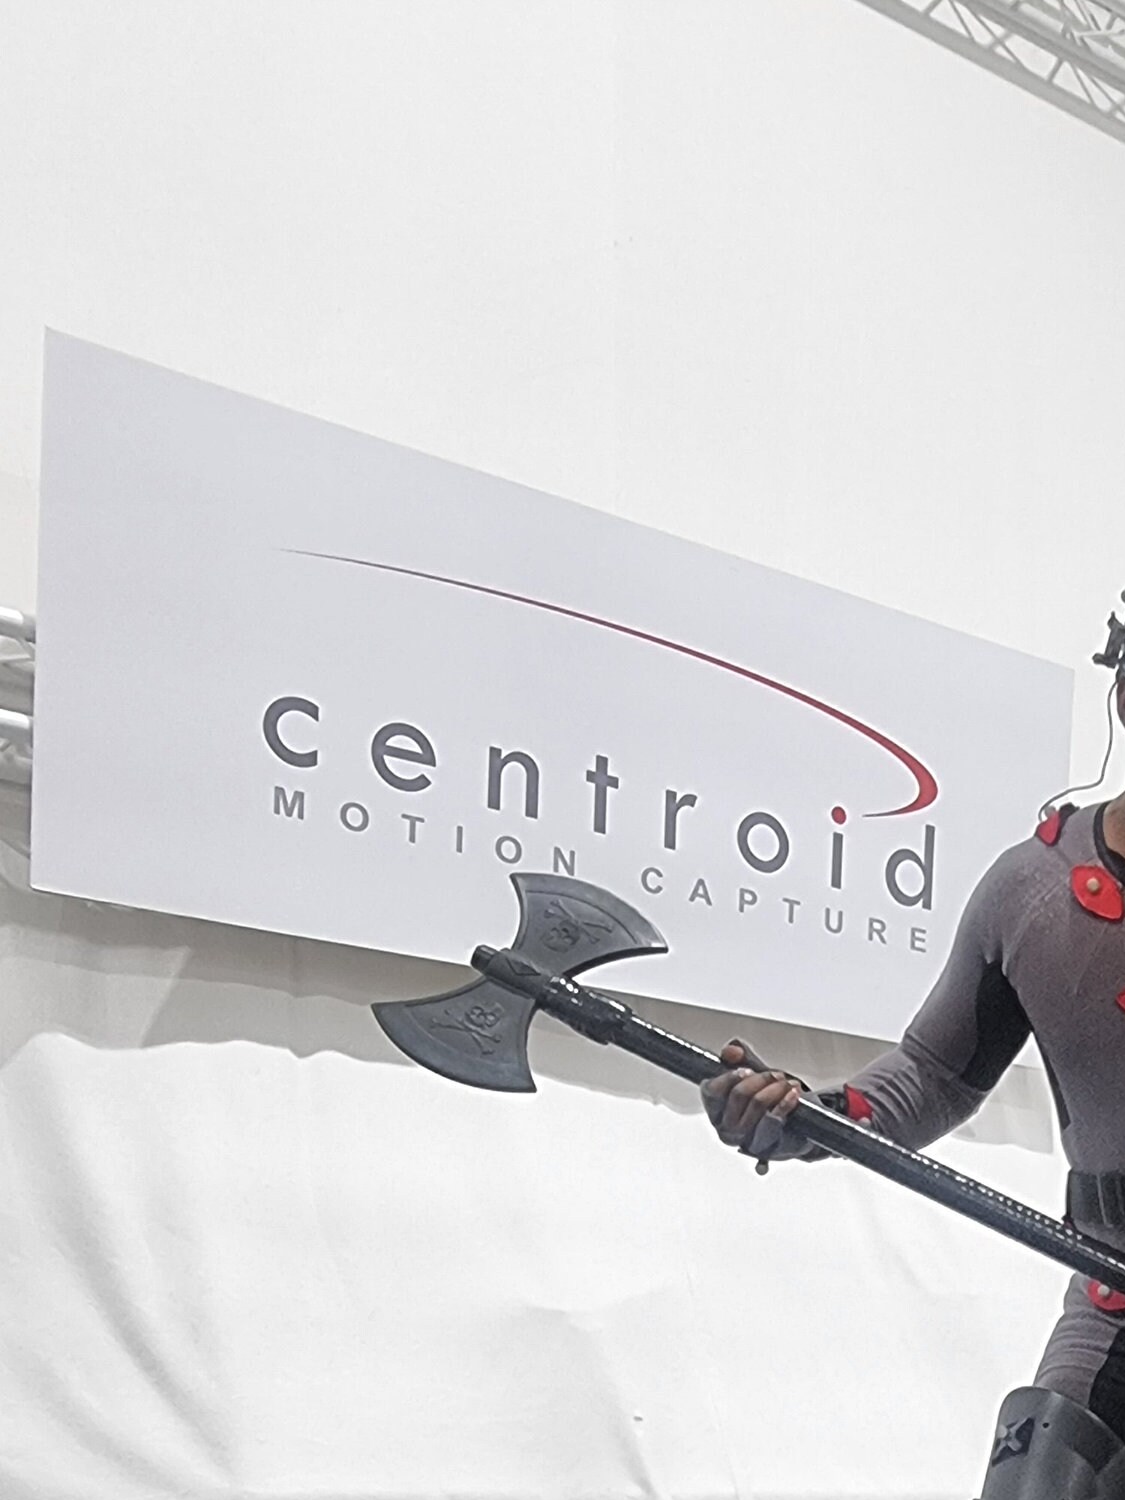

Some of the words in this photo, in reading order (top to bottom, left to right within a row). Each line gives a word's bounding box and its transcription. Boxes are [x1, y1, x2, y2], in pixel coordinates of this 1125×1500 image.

[262, 696, 936, 911] centroid
[273, 785, 577, 877] MOTION
[640, 867, 928, 953] CAPTURE
